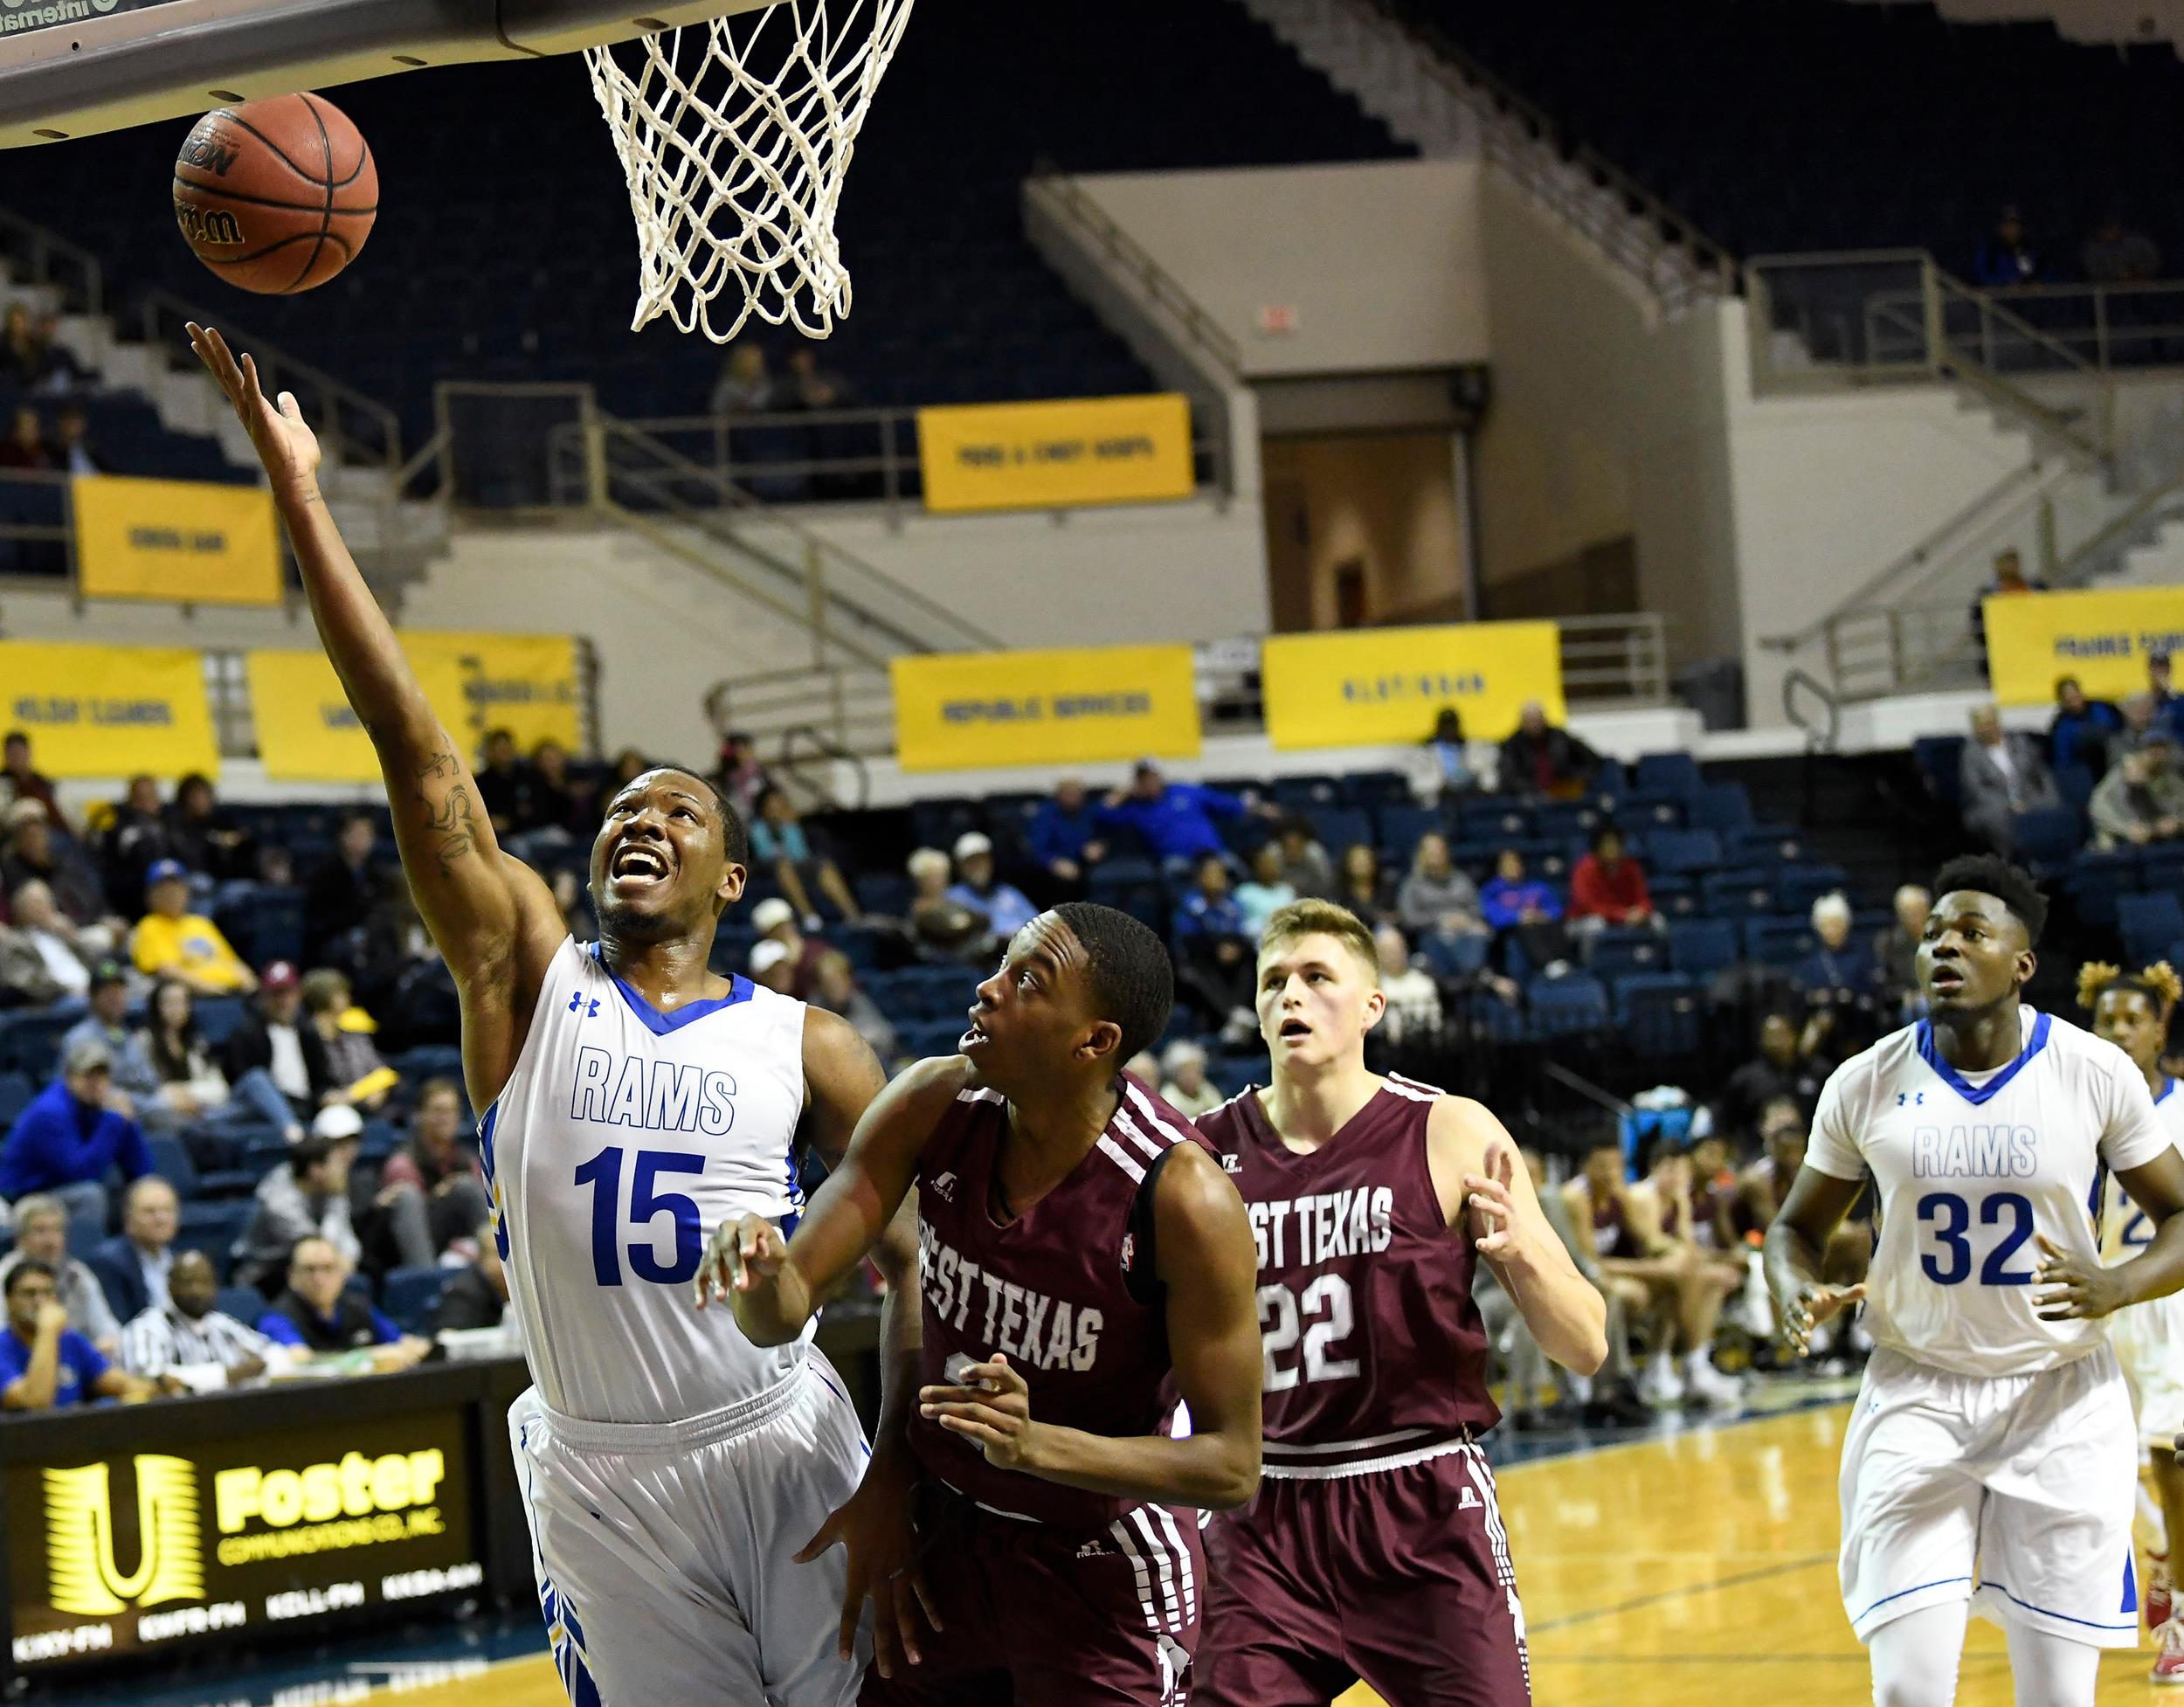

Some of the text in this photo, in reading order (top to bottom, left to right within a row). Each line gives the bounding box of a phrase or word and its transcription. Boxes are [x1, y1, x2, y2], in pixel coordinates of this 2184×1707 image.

[570, 1046, 737, 1136] RAMS
[1912, 1124, 2036, 1178] RAMS
[574, 1146, 707, 1287] 15
[1245, 1185, 1393, 1270] ST TEXAS
[1917, 1192, 2039, 1286] 32
[981, 1269, 1104, 1372] TEXAS
[1255, 1273, 1361, 1393] 22
[215, 1448, 445, 1534] Foster
